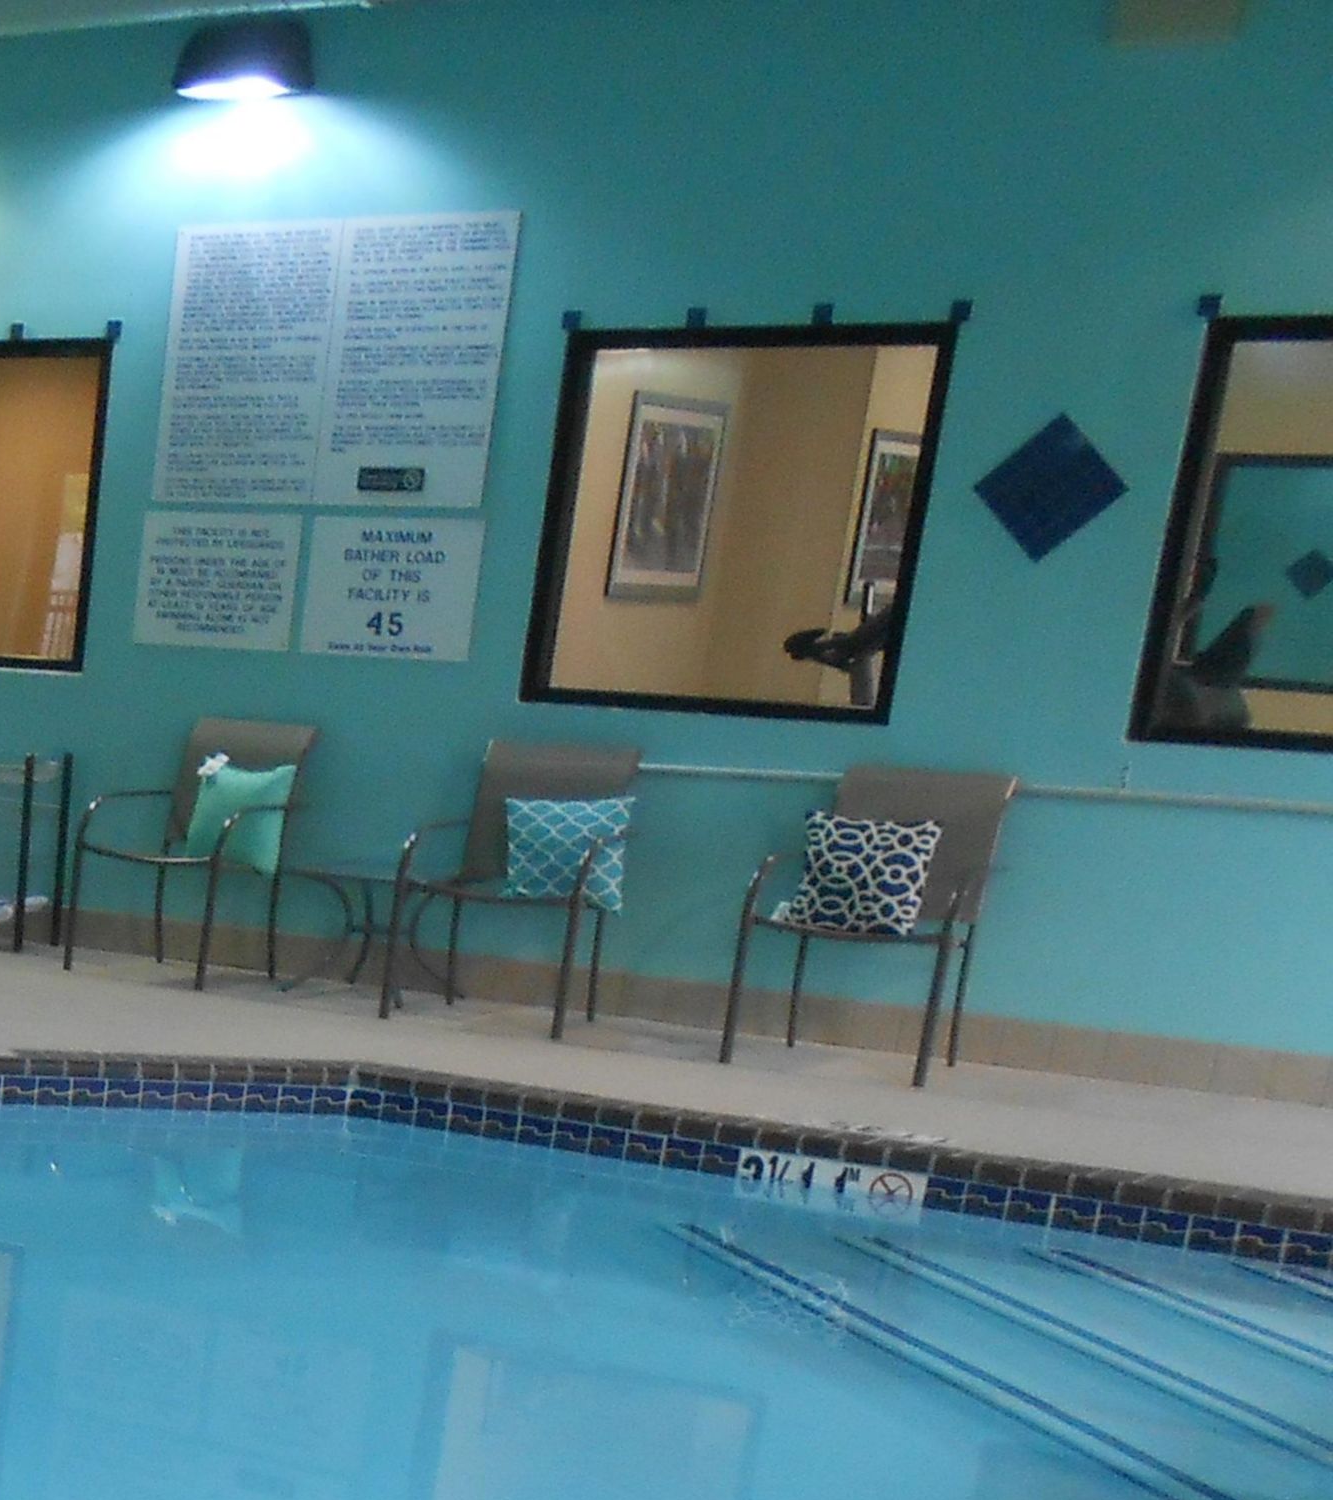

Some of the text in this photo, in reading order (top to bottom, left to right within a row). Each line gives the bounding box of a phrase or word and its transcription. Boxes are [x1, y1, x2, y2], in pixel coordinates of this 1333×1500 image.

[361, 530, 433, 543] MAXIMUM
[344, 548, 446, 564] BATHER LOAD
[362, 568, 422, 583] OF THIS
[348, 587, 430, 602] FACILITY IS
[366, 611, 403, 636] 45
